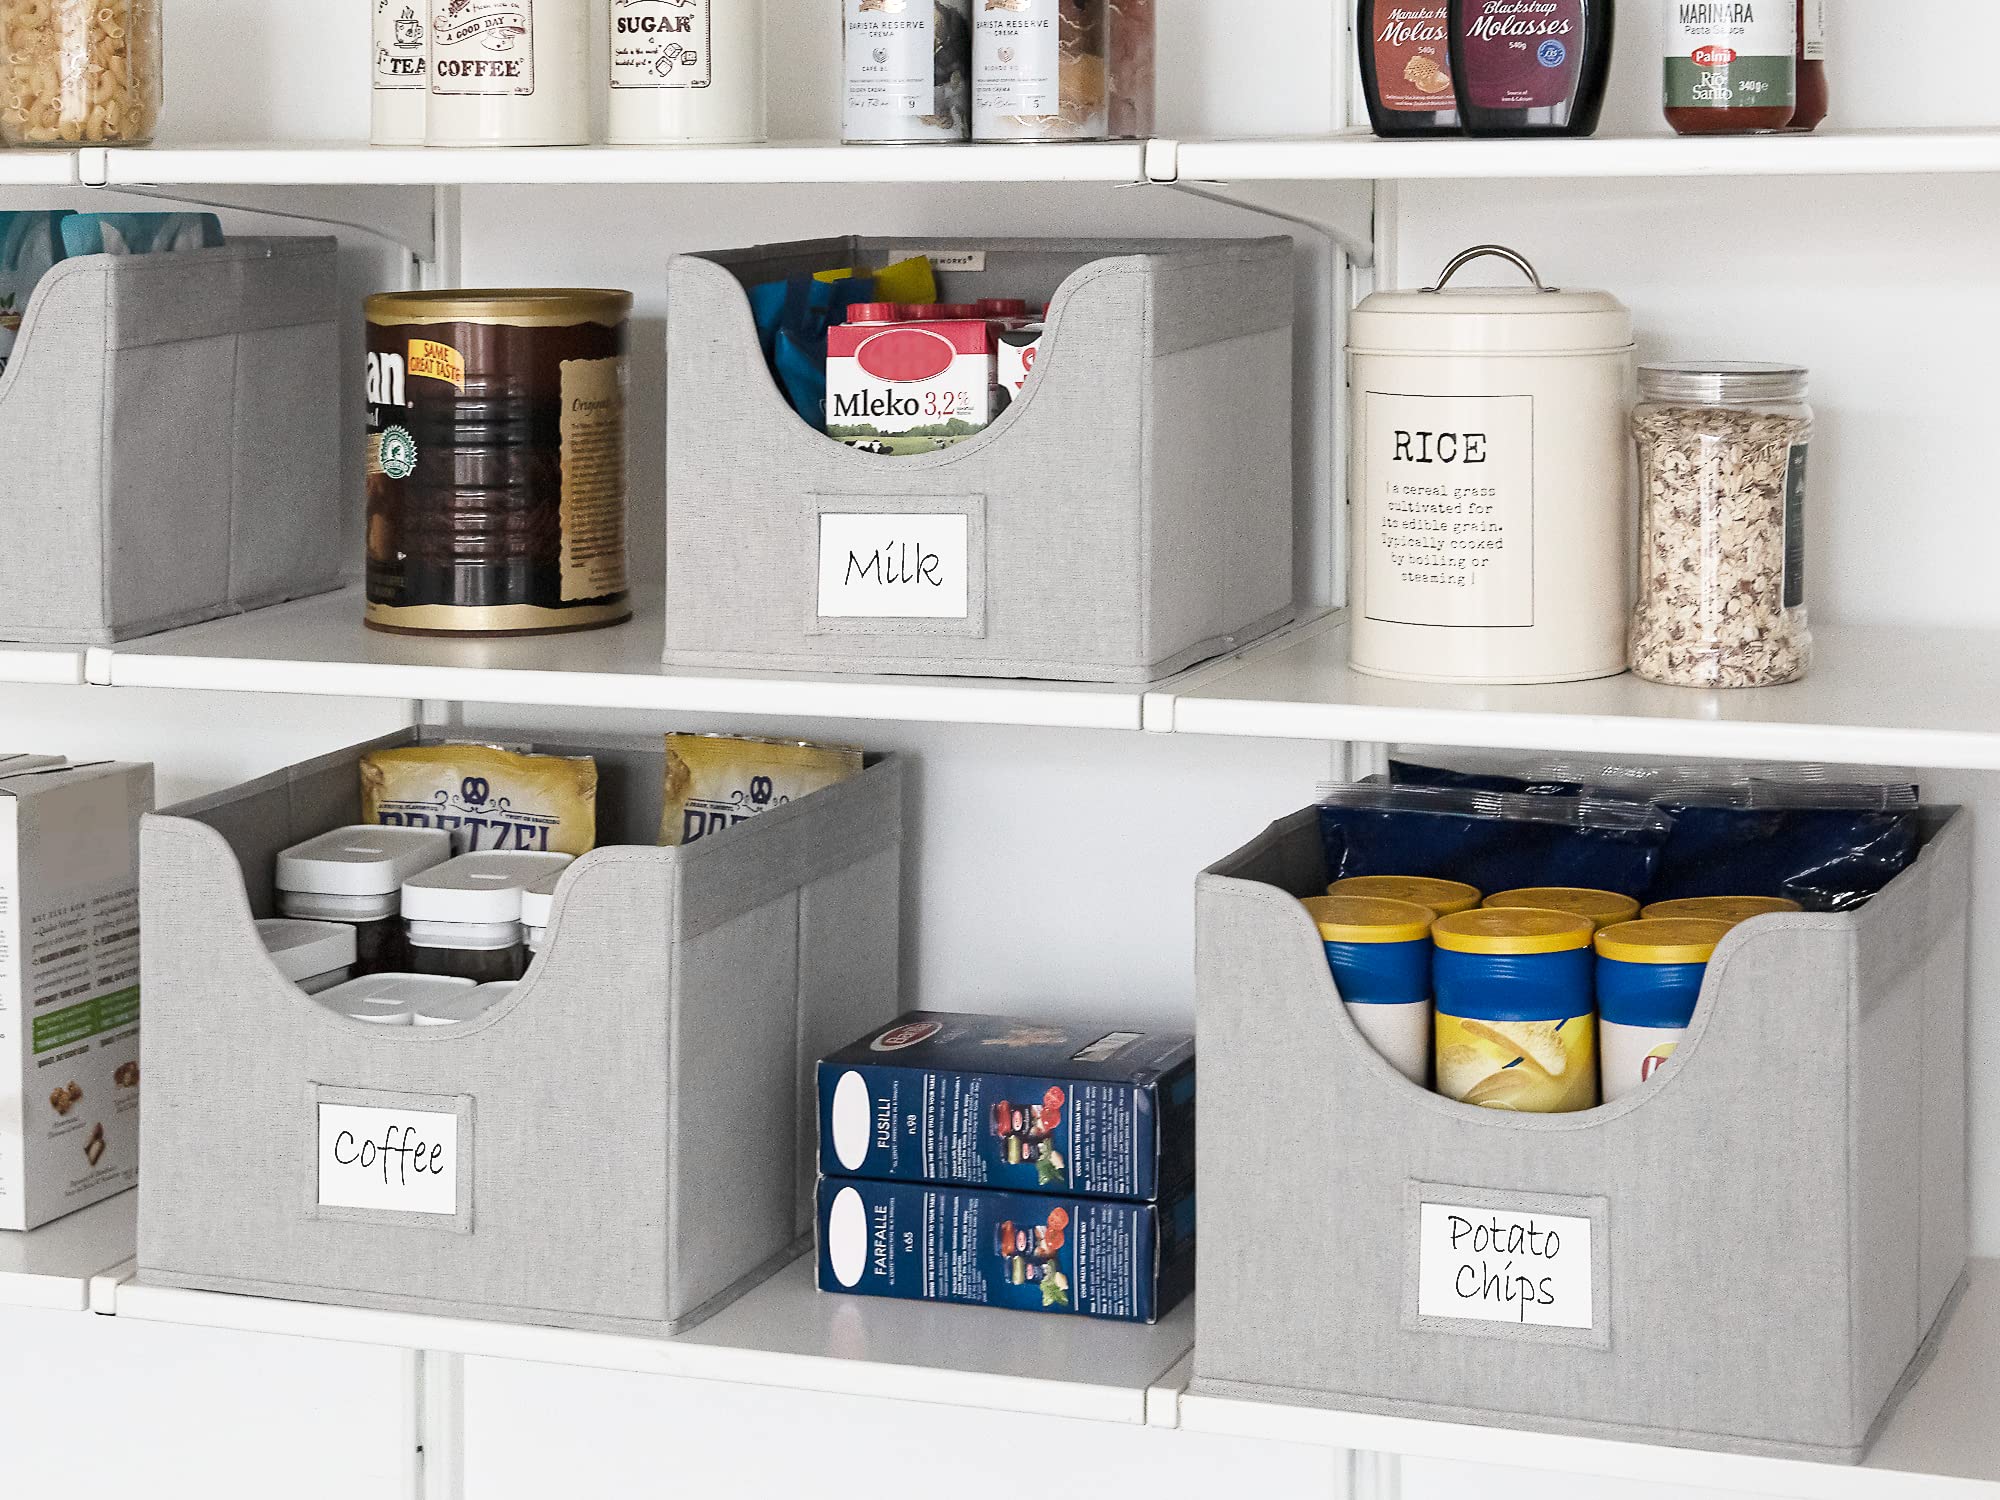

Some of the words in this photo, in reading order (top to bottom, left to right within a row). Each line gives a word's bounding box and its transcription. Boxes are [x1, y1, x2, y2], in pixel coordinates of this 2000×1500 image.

[1388, 7, 1434, 22] Manuka
[1482, 0, 1557, 17] Blackstrap
[1679, 3, 1754, 24] MARINARA
[456, 23, 480, 39] GOOD
[485, 17, 505, 28] DAY
[617, 16, 691, 33] SUGAR
[849, 22, 879, 30] BARISTA
[881, 21, 925, 29] RESERVE
[976, 20, 1003, 29] BARISTA
[1006, 19, 1049, 28] RESERVE
[1466, 15, 1573, 41] Molasses
[1685, 25, 1711, 35] Pasta
[1714, 26, 1745, 35] Sauce
[1509, 41, 1527, 51] 540g
[1696, 50, 1731, 62] Palmi
[390, 58, 425, 73] TEA
[437, 60, 520, 77] COFFEE
[909, 100, 915, 108] 9
[1033, 99, 1039, 108] 5
[424, 342, 449, 362] SAME
[410, 357, 434, 373] GREAT
[435, 360, 461, 382] TASTE
[834, 388, 919, 417] Mleko
[1392, 430, 1487, 463] RICE
[1403, 484, 1448, 496] cereal
[1453, 486, 1496, 499] grass
[1388, 500, 1462, 514] cultivated
[1468, 502, 1493, 514] for
[1402, 519, 1448, 531] edible
[1453, 521, 1503, 535] grain.
[1450, 538, 1504, 550] cooked
[844, 540, 943, 586] Milk
[1391, 552, 1404, 566] by
[1408, 554, 1466, 570] boiling
[1471, 556, 1489, 567] or
[1401, 572, 1465, 587] steaming
[877, 1098, 891, 1148] FUSILLI
[907, 1114, 917, 1135] n.98
[335, 1125, 443, 1185] Coffee
[874, 1205, 888, 1275] FARFALLE
[903, 1231, 914, 1252] n.65
[1448, 1215, 1560, 1259] Potato
[1456, 1261, 1554, 1322] Chips
